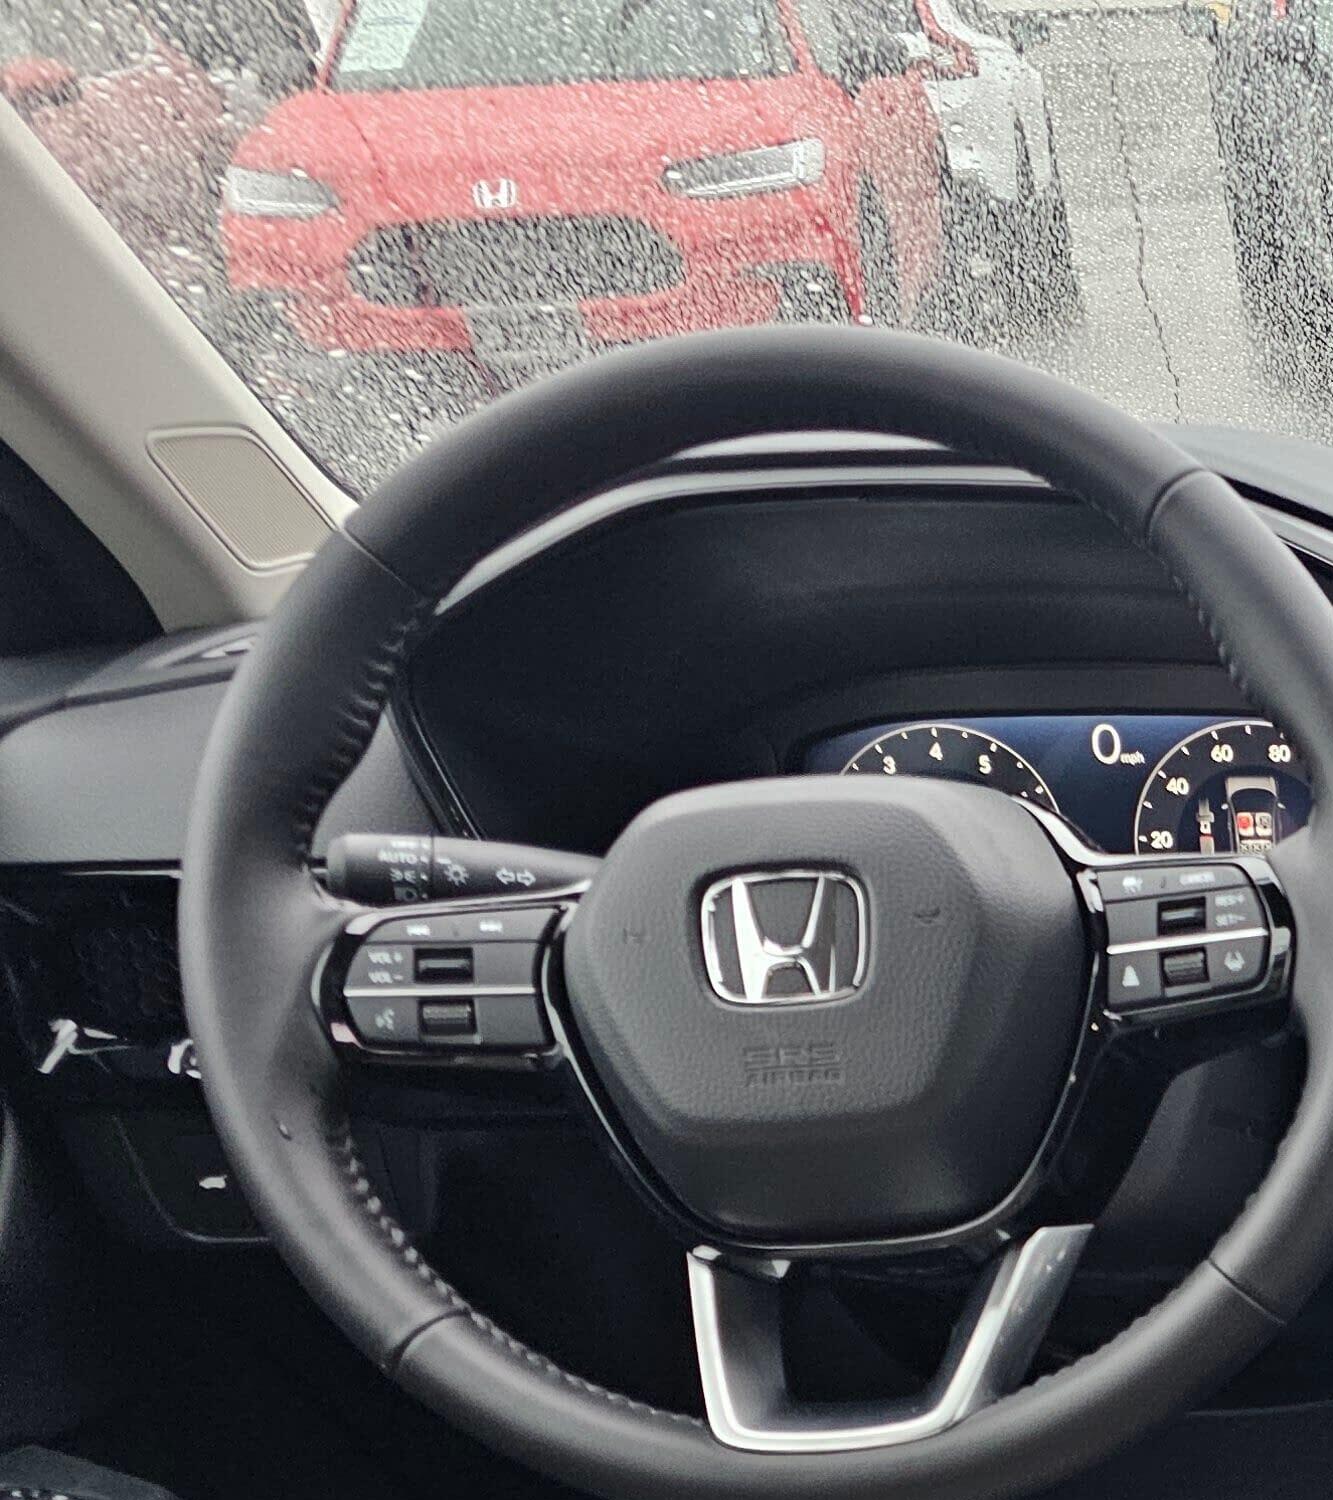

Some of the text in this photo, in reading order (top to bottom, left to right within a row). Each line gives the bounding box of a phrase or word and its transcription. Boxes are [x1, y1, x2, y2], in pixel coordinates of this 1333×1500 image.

[929, 741, 944, 761] 4
[1091, 723, 1145, 766] 0 mph
[1210, 743, 1235, 763] 60
[1267, 743, 1292, 763] 80
[883, 755, 897, 775] 3
[978, 753, 993, 775] 5
[1165, 776, 1190, 796] 40
[1150, 830, 1174, 849] 20
[376, 849, 418, 865] AUTO
